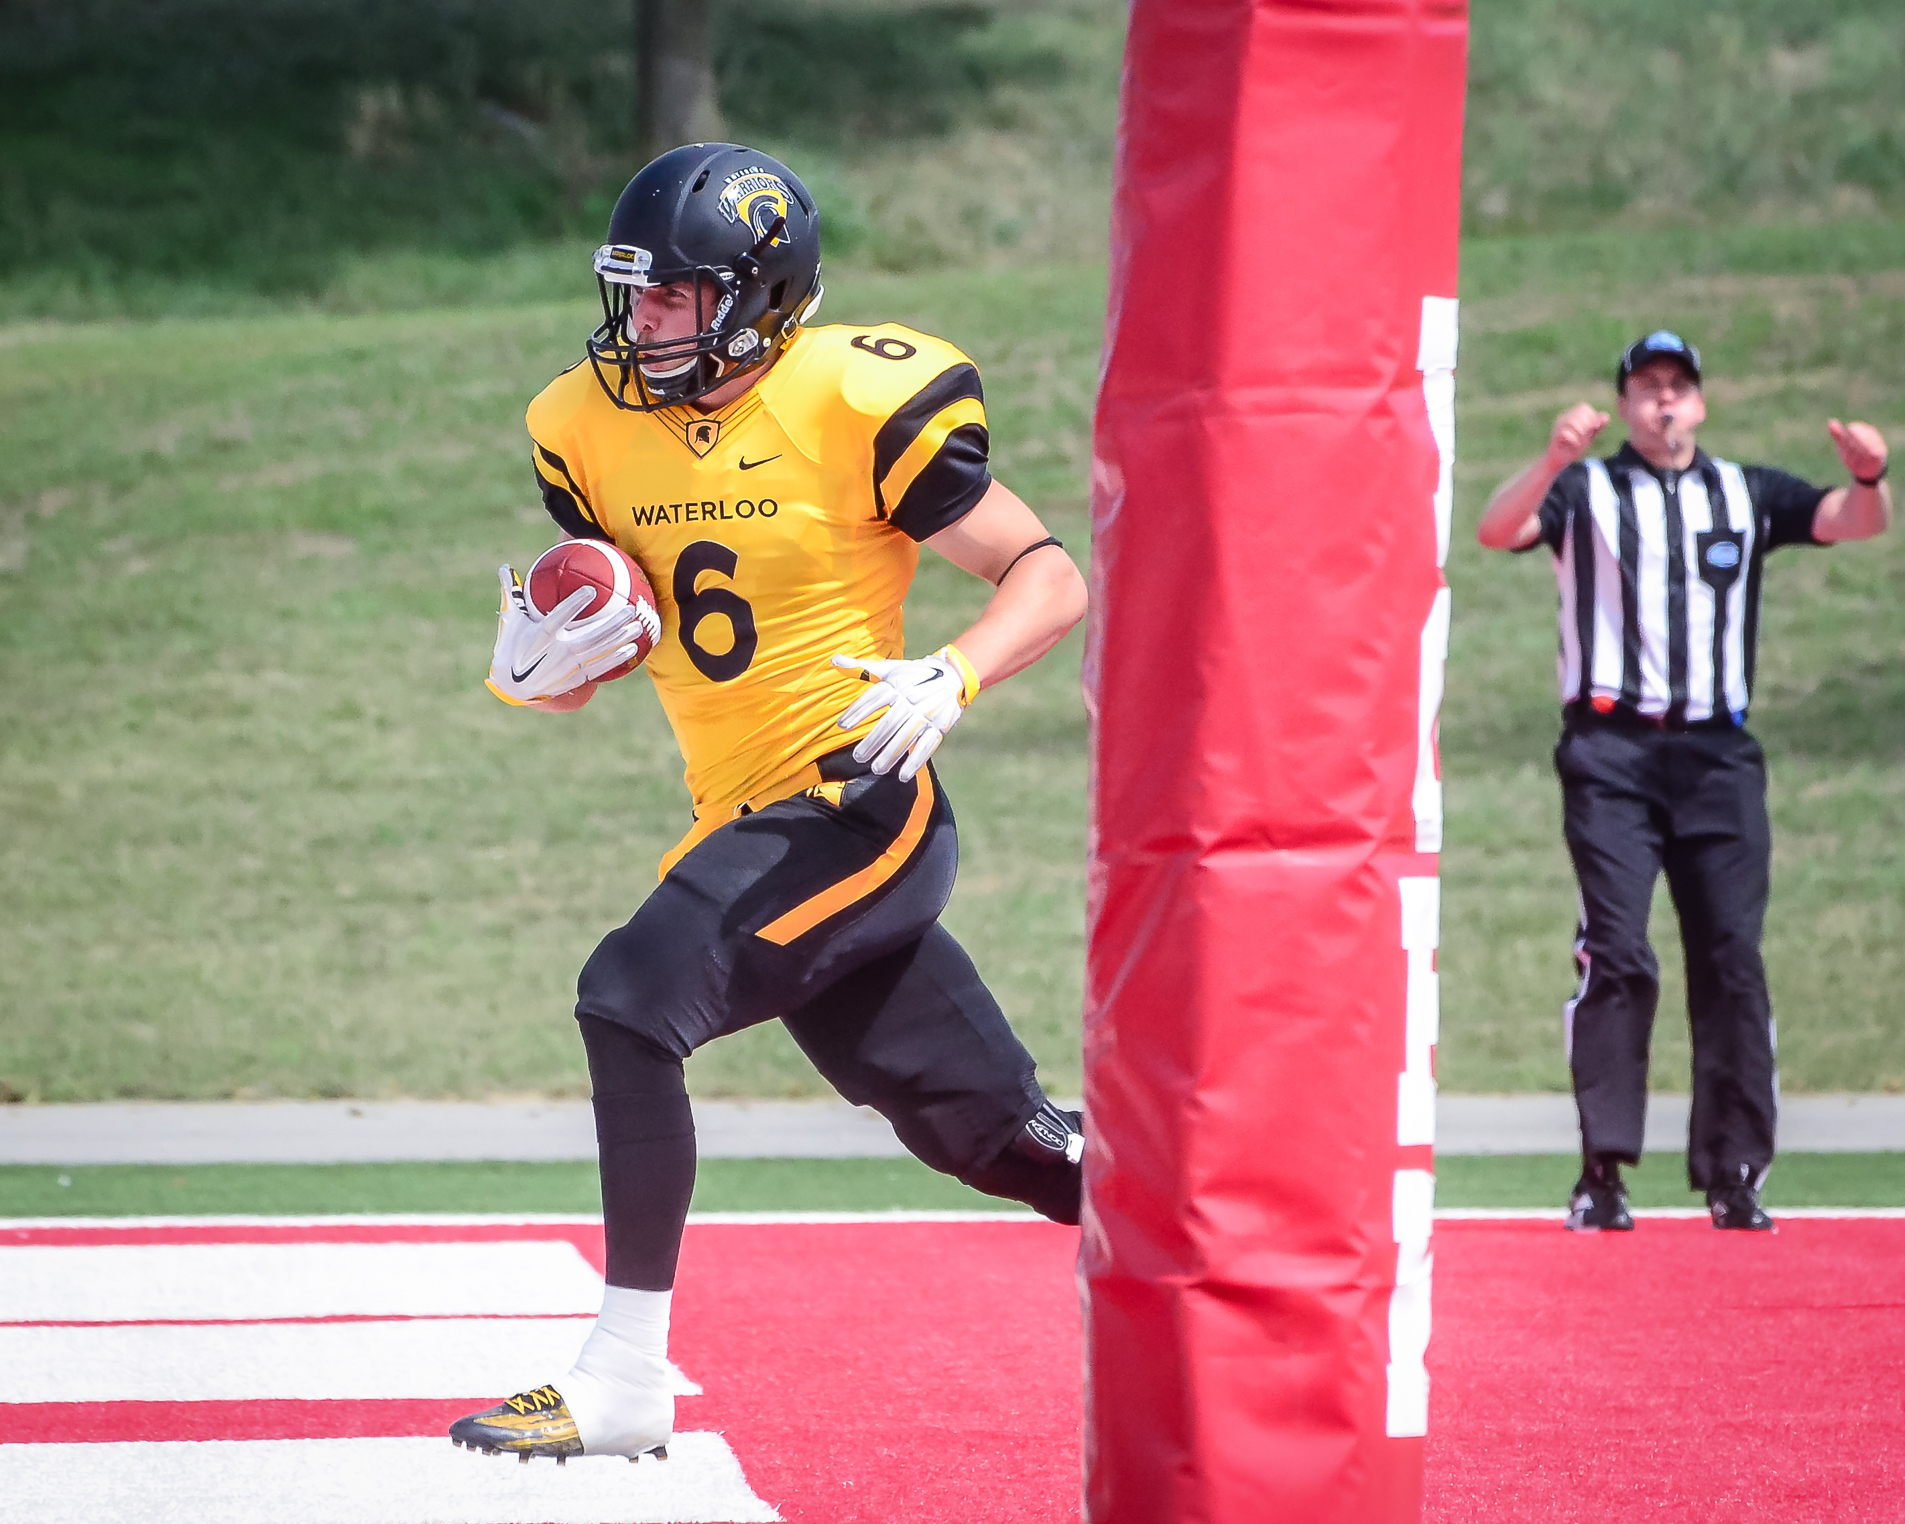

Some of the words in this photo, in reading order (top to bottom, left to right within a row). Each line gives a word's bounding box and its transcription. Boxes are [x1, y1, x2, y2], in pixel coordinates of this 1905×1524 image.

[851, 335, 916, 360] 6
[632, 498, 778, 526] WATERLOO
[673, 540, 758, 682] 6
